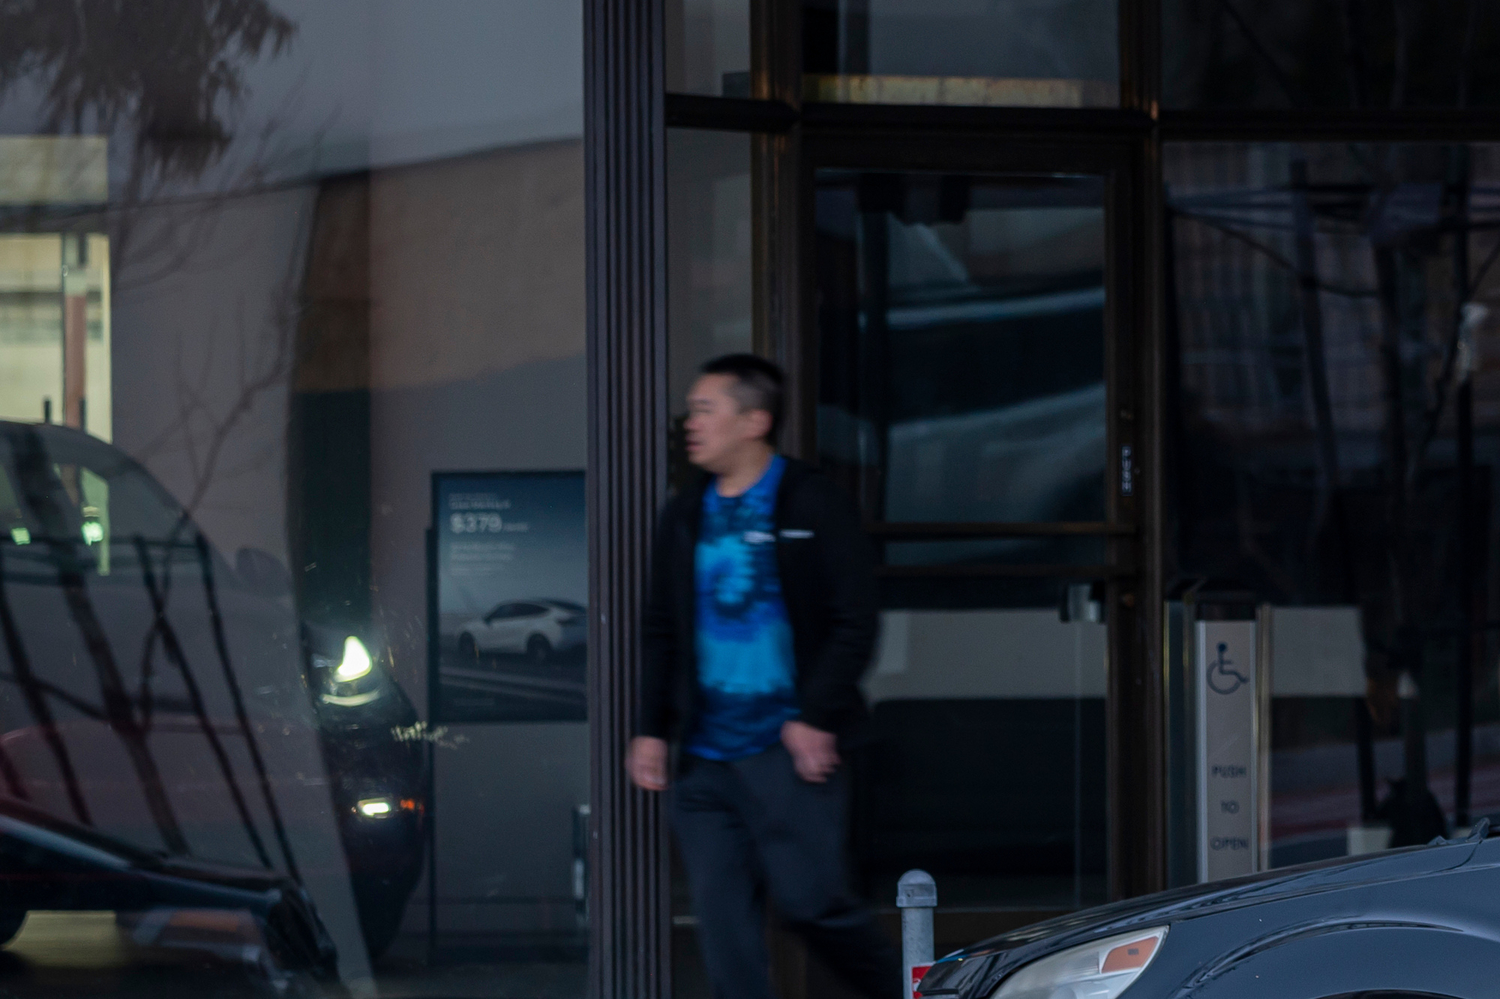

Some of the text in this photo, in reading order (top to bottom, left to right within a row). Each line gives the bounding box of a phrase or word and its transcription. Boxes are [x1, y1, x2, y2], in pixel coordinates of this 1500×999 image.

[1121, 446, 1132, 492] PUSH
[450, 512, 502, 534] $379
[1211, 764, 1247, 778] PUSH
[1220, 800, 1240, 814] TO
[1210, 836, 1249, 851] OPEN
